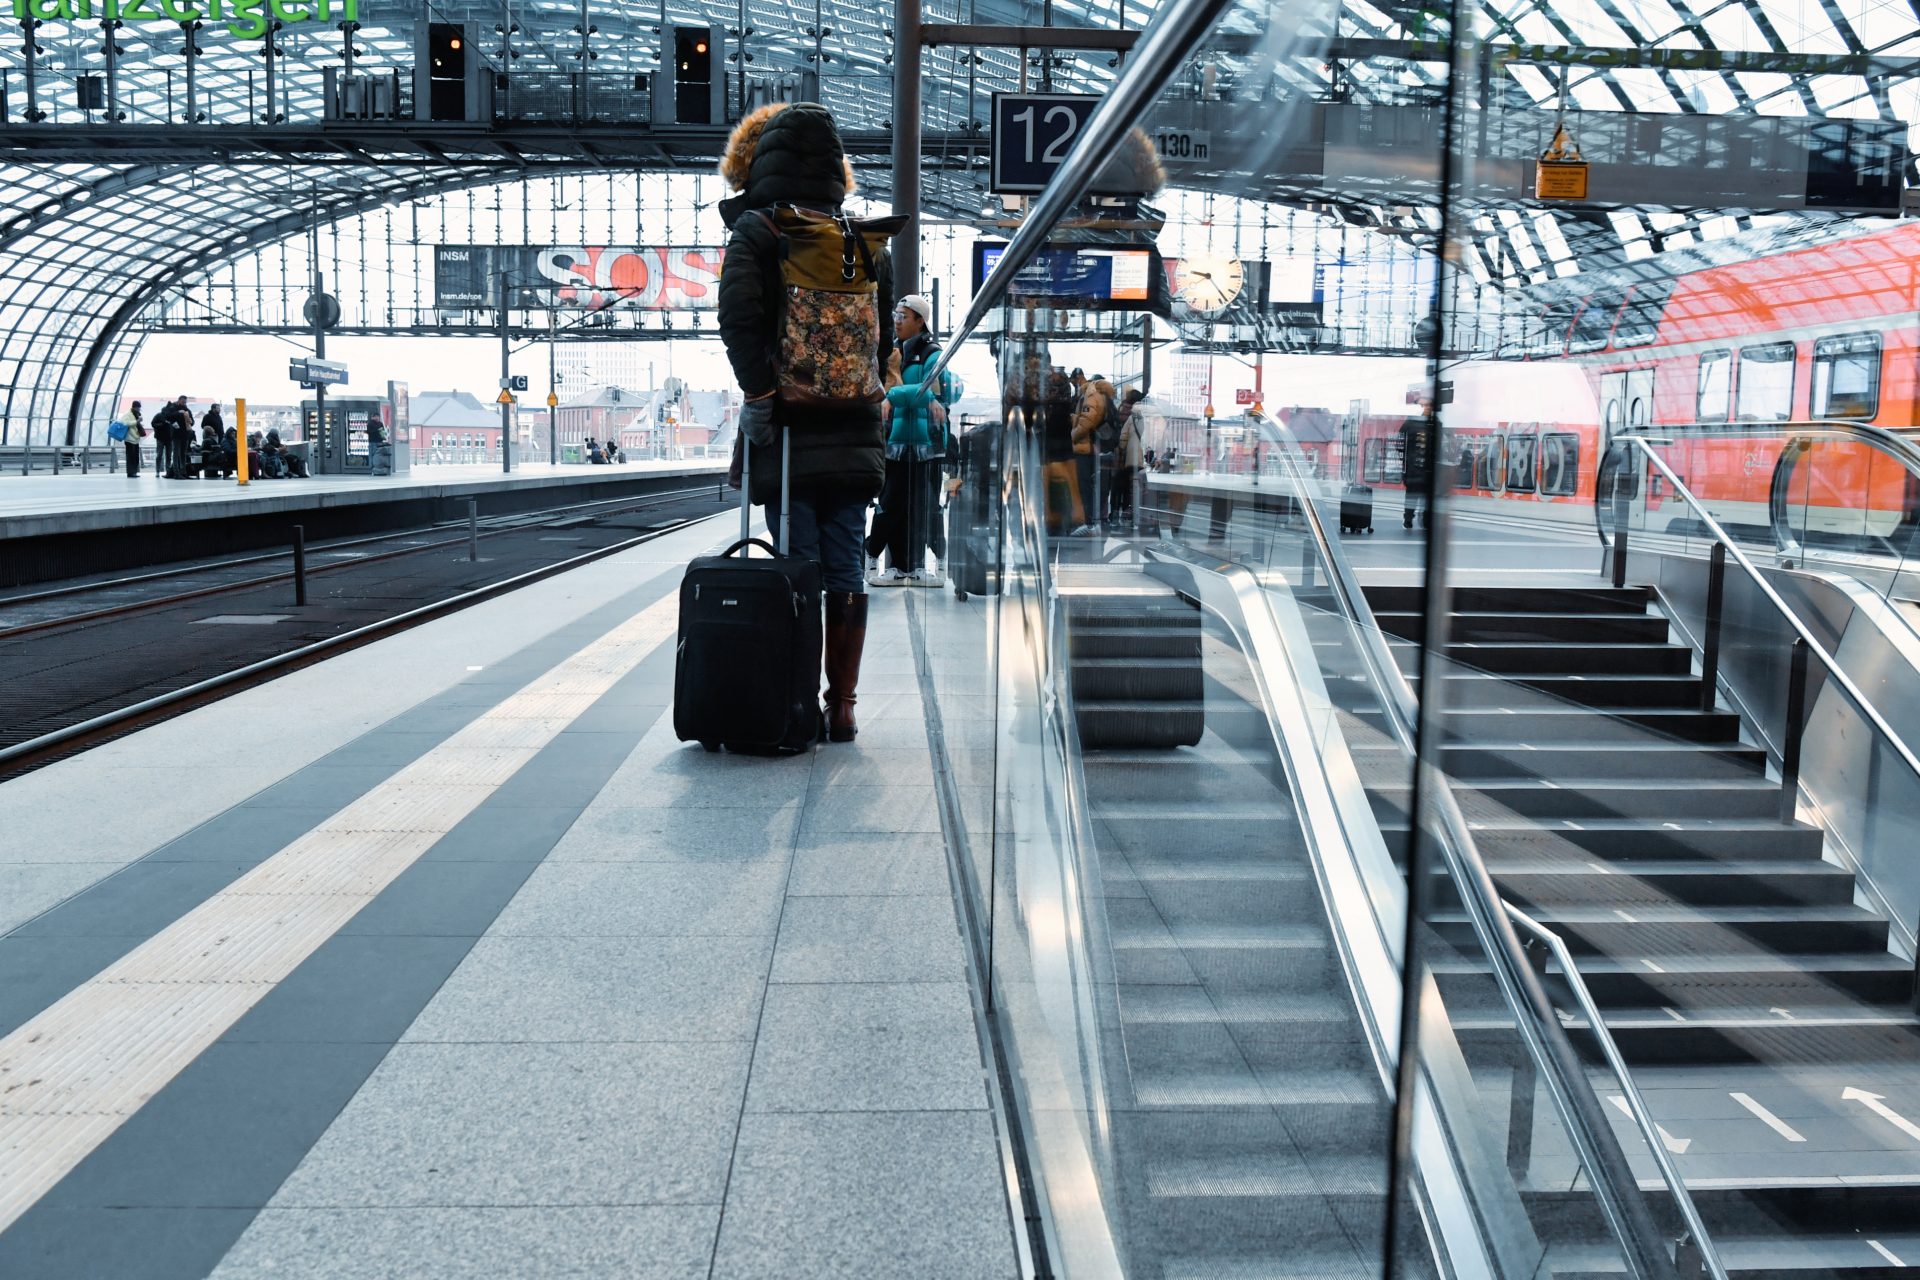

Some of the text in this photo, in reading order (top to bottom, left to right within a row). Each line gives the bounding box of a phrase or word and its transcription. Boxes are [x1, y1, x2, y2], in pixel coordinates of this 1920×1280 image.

[13, 0, 358, 39] anzeigen
[1012, 105, 1078, 164] 12
[1159, 133, 1207, 158] 130 m
[440, 251, 469, 261] INSM
[537, 246, 721, 308] SOS
[516, 375, 526, 388] G
